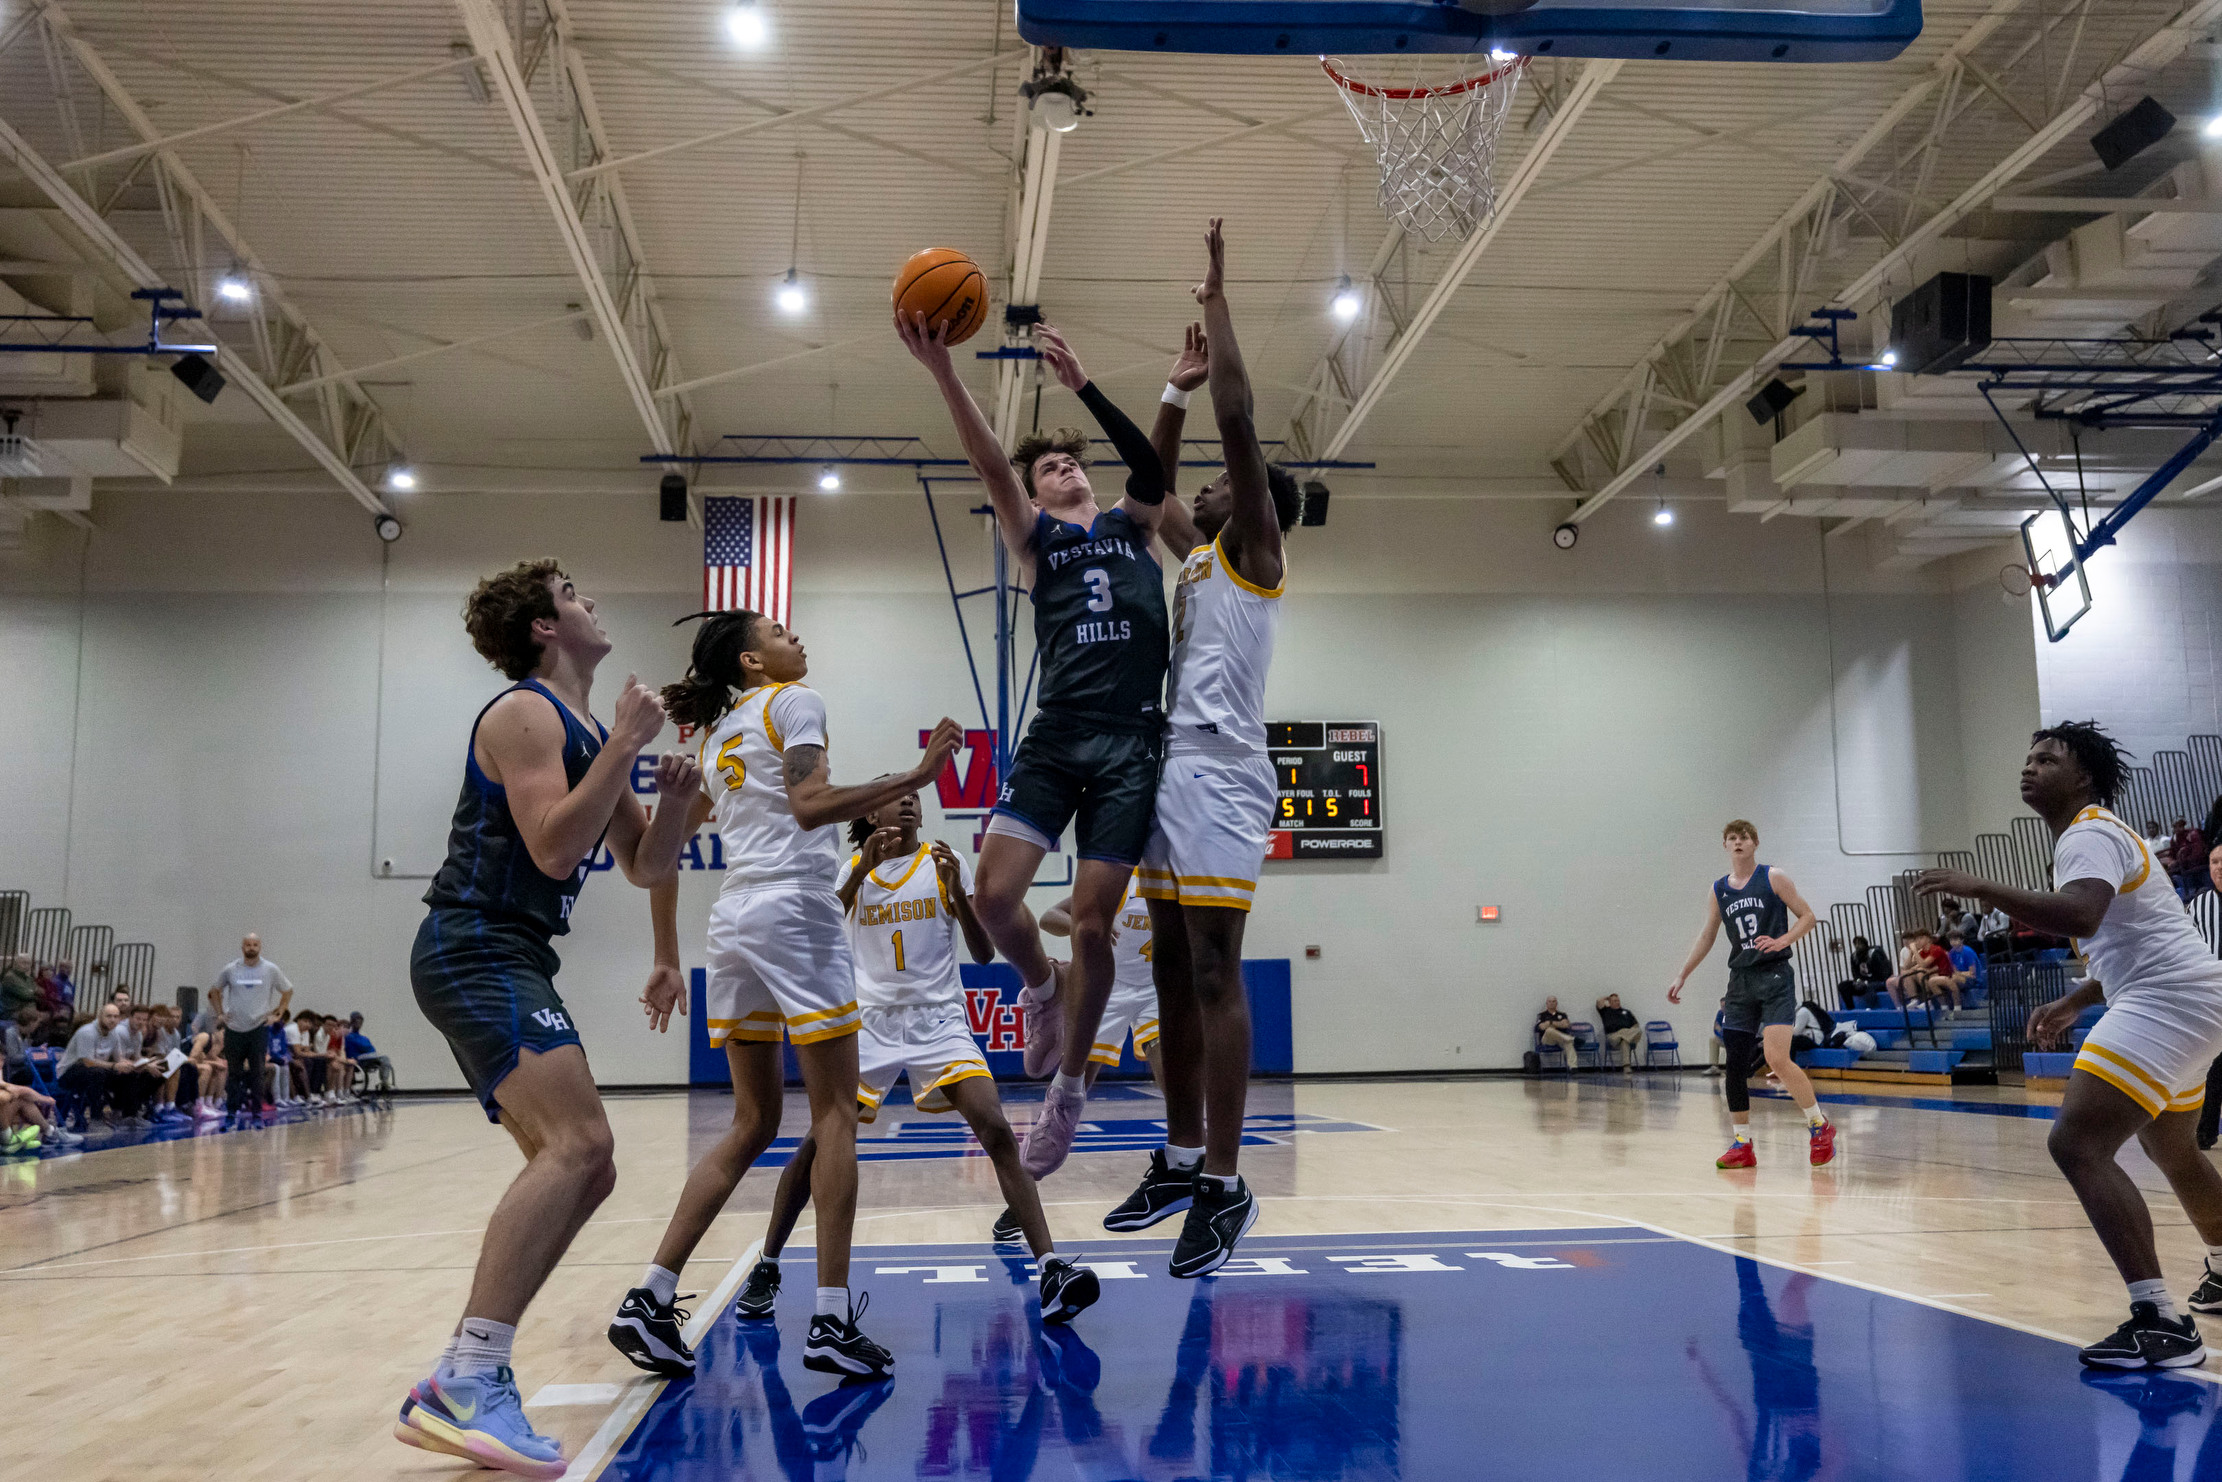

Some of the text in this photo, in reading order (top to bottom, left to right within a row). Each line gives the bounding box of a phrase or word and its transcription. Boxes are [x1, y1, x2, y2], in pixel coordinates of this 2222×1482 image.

[1048, 538, 1136, 571] VESTAVIA
[1083, 568, 1113, 612] 3
[1076, 620, 1131, 644] HILLS
[1328, 729, 1375, 742] REBEL
[716, 732, 747, 791] 5
[1277, 757, 1303, 765] PERIOD
[1333, 751, 1367, 762] GUEST
[1291, 768, 1297, 785] 1
[1355, 764, 1368, 786] 7
[1277, 789, 1295, 798] AYER
[1296, 789, 1315, 798] FOUL
[1348, 789, 1372, 798] FOULS
[1282, 798, 1369, 817] 5 1 5 1
[1278, 819, 1373, 828] MATCH SCORE
[1301, 839, 1375, 849] POWERADE
[860, 897, 937, 927] JEMISON
[1725, 897, 1765, 918] VESTAVIA
[1735, 913, 1758, 940] 13
[891, 930, 906, 972] 1
[531, 1007, 571, 1032] VH
[964, 988, 1025, 1052] VH
